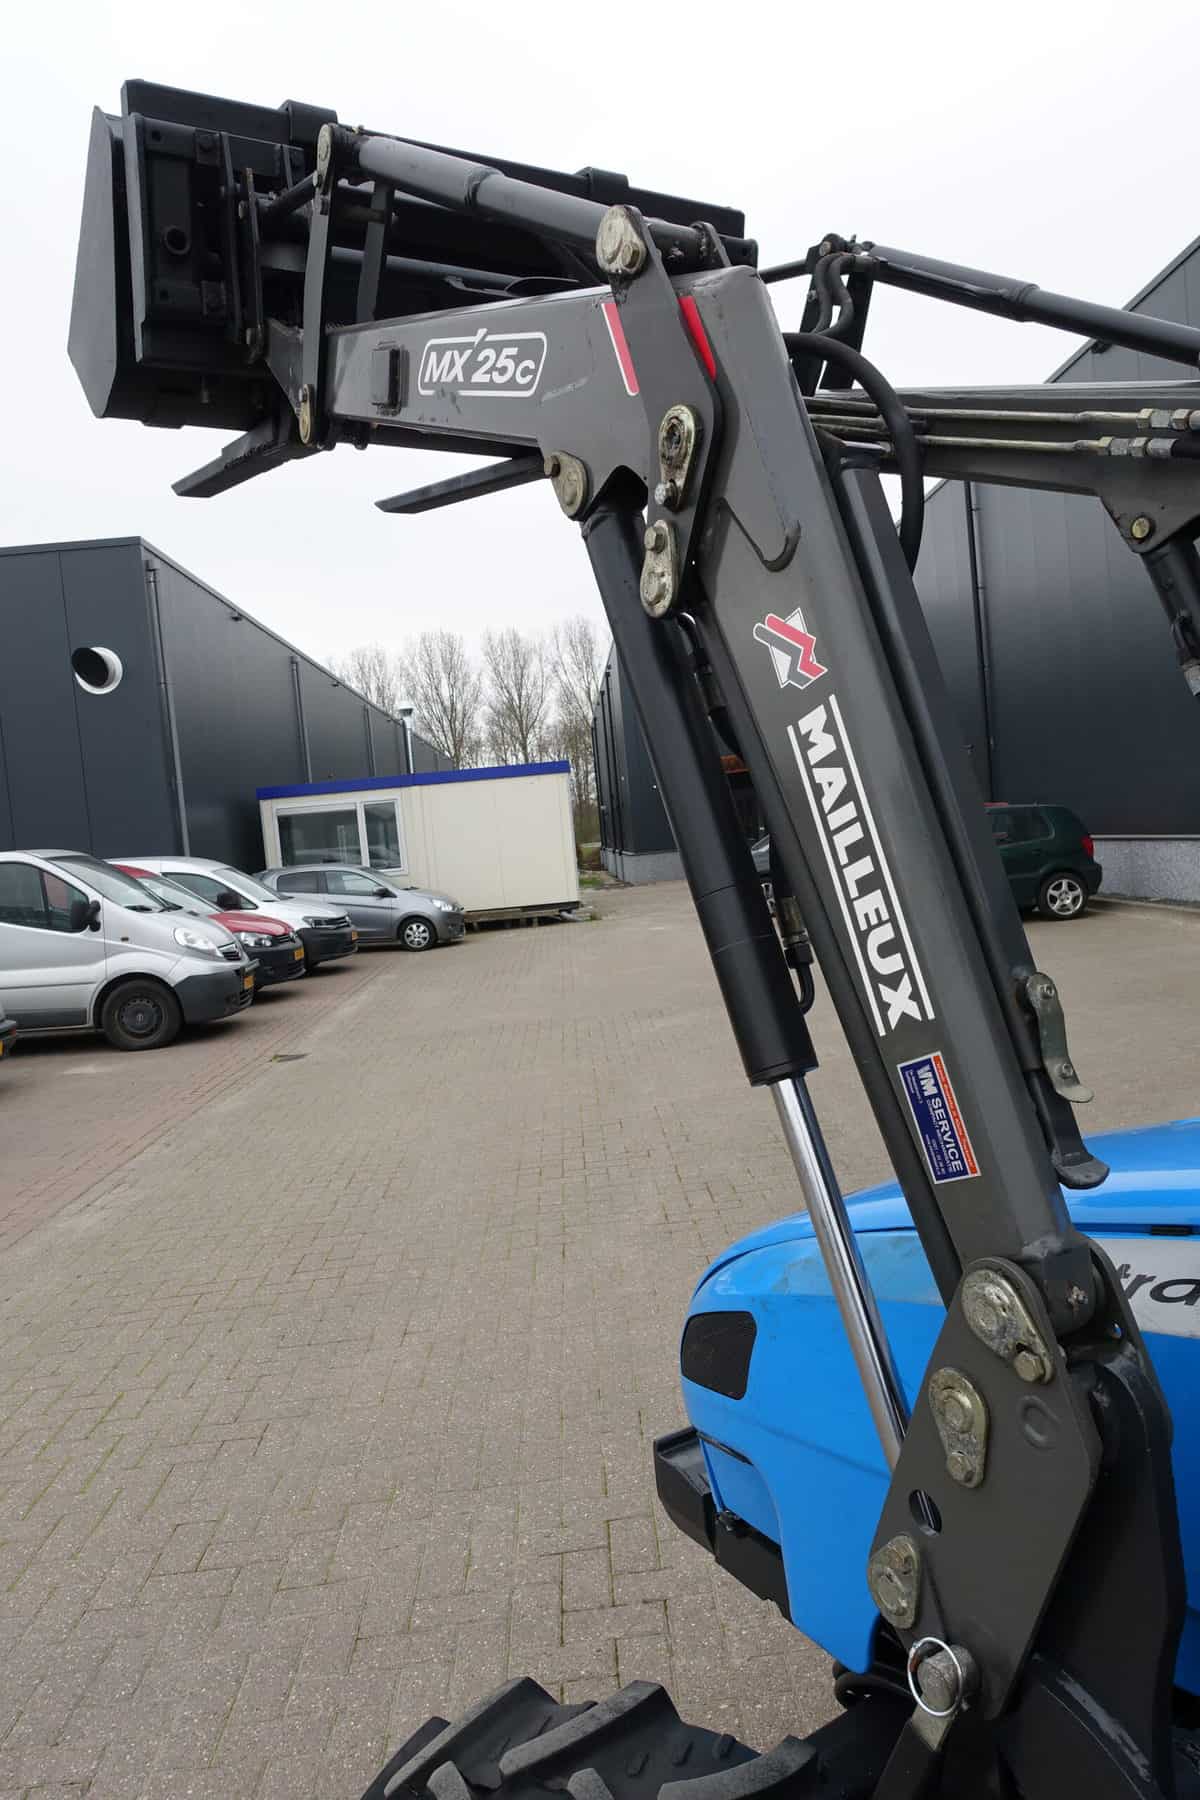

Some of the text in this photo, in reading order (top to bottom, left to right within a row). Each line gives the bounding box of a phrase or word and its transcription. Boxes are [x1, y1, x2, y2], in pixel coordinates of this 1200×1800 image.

[424, 349, 473, 383] MX
[798, 704, 922, 1030] MAILLEUX
[931, 1097, 964, 1173] SERVICE
